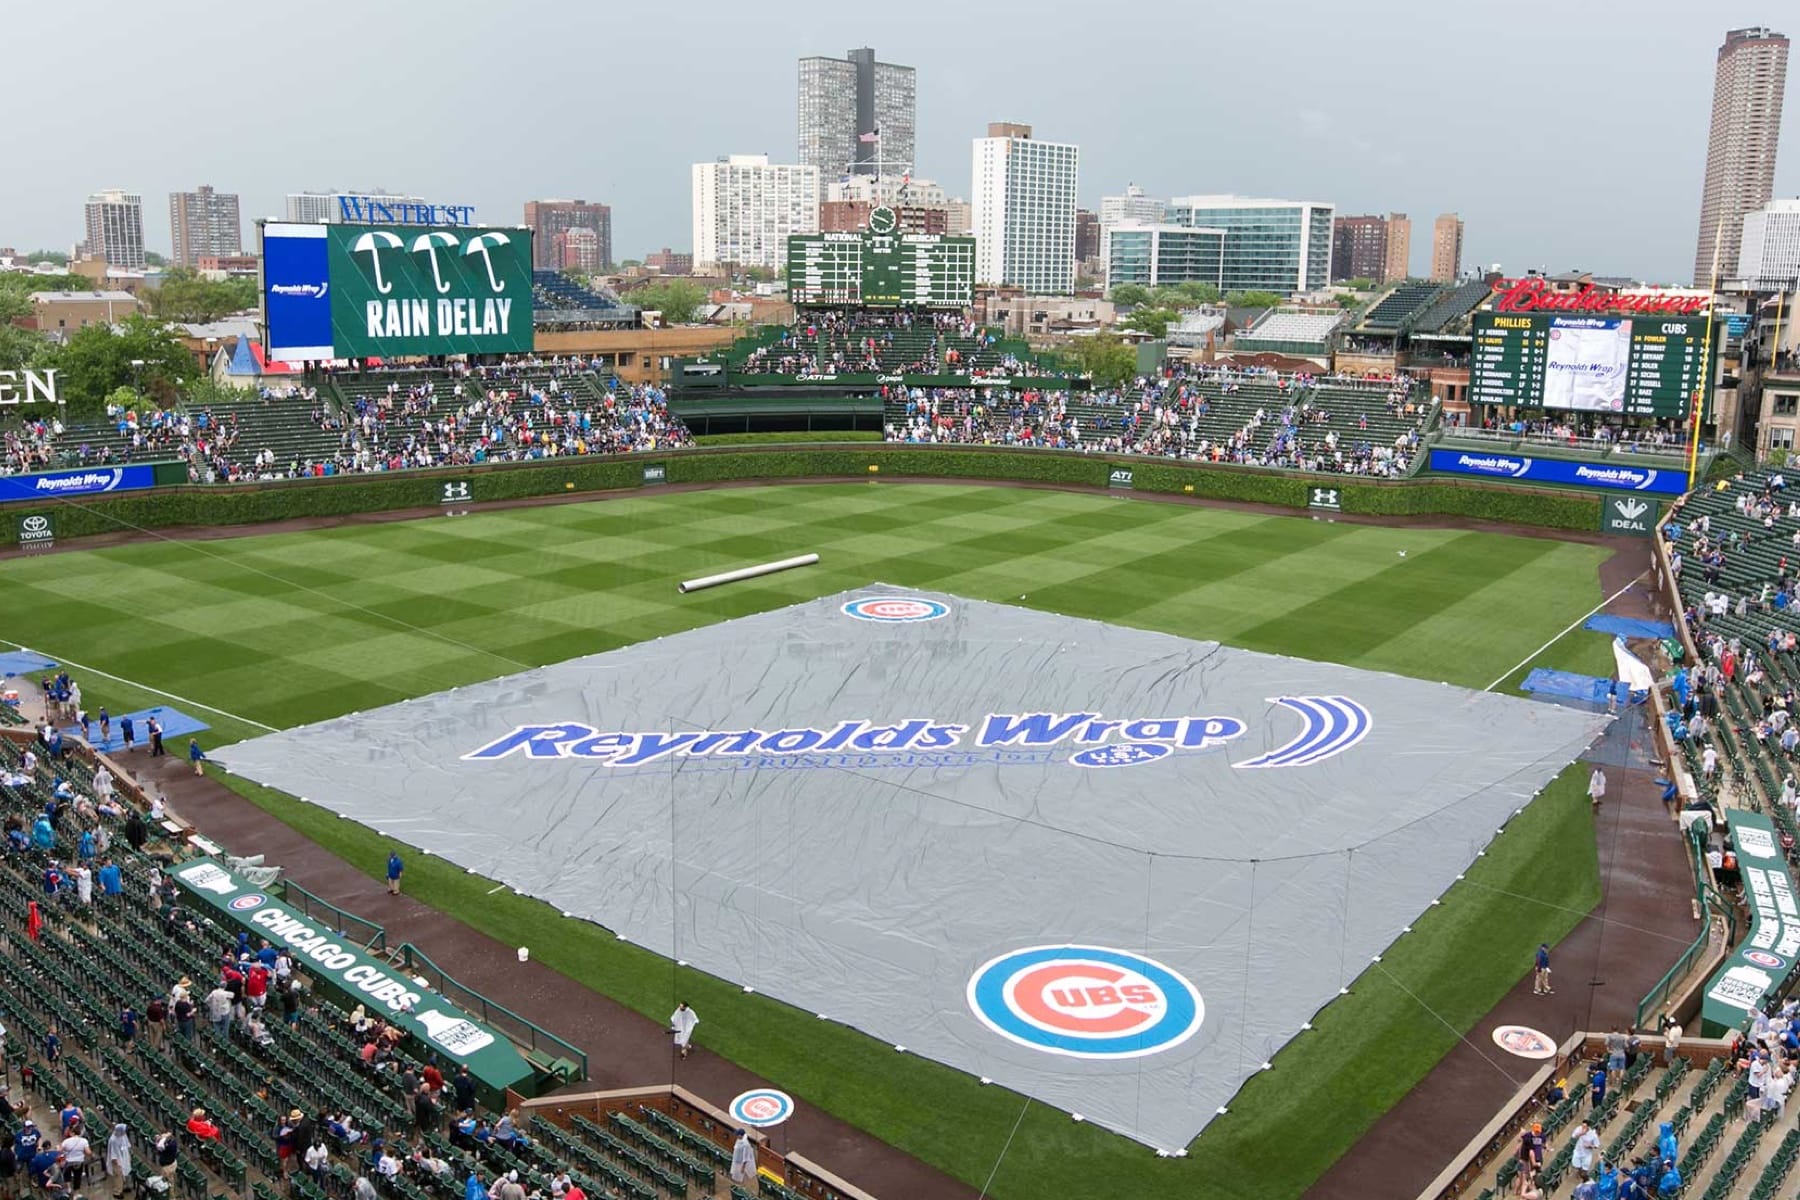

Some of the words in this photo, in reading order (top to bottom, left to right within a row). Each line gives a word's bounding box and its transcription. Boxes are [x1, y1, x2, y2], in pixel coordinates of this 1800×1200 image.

[337, 196, 475, 226] WINTRUST
[824, 233, 863, 241] NATIONAL
[1492, 277, 1710, 314] Budweiser
[366, 299, 430, 338] RAIN
[437, 298, 512, 336] DELAY
[1494, 317, 1532, 328] PHILLIES
[1661, 322, 1688, 335] CUBS
[1548, 361, 1588, 371] Reynolds
[1590, 363, 1614, 374] Wrap
[0, 368, 60, 404] EN
[1458, 454, 1497, 467] Reynolds
[1497, 459, 1520, 472] Wrap
[36, 475, 83, 490] Reynolds
[84, 473, 111, 486] Wrap
[1110, 470, 1133, 480] ATI
[1575, 466, 1619, 479] Reynolds
[1619, 469, 1644, 483] Wrap
[1611, 518, 1647, 531] IDEAL
[20, 529, 53, 540] TOYOTA
[460, 719, 967, 767] Reynolds
[977, 711, 1248, 749] Wrap
[252, 908, 356, 970] CHICAGO
[343, 965, 421, 1010] CUBS
